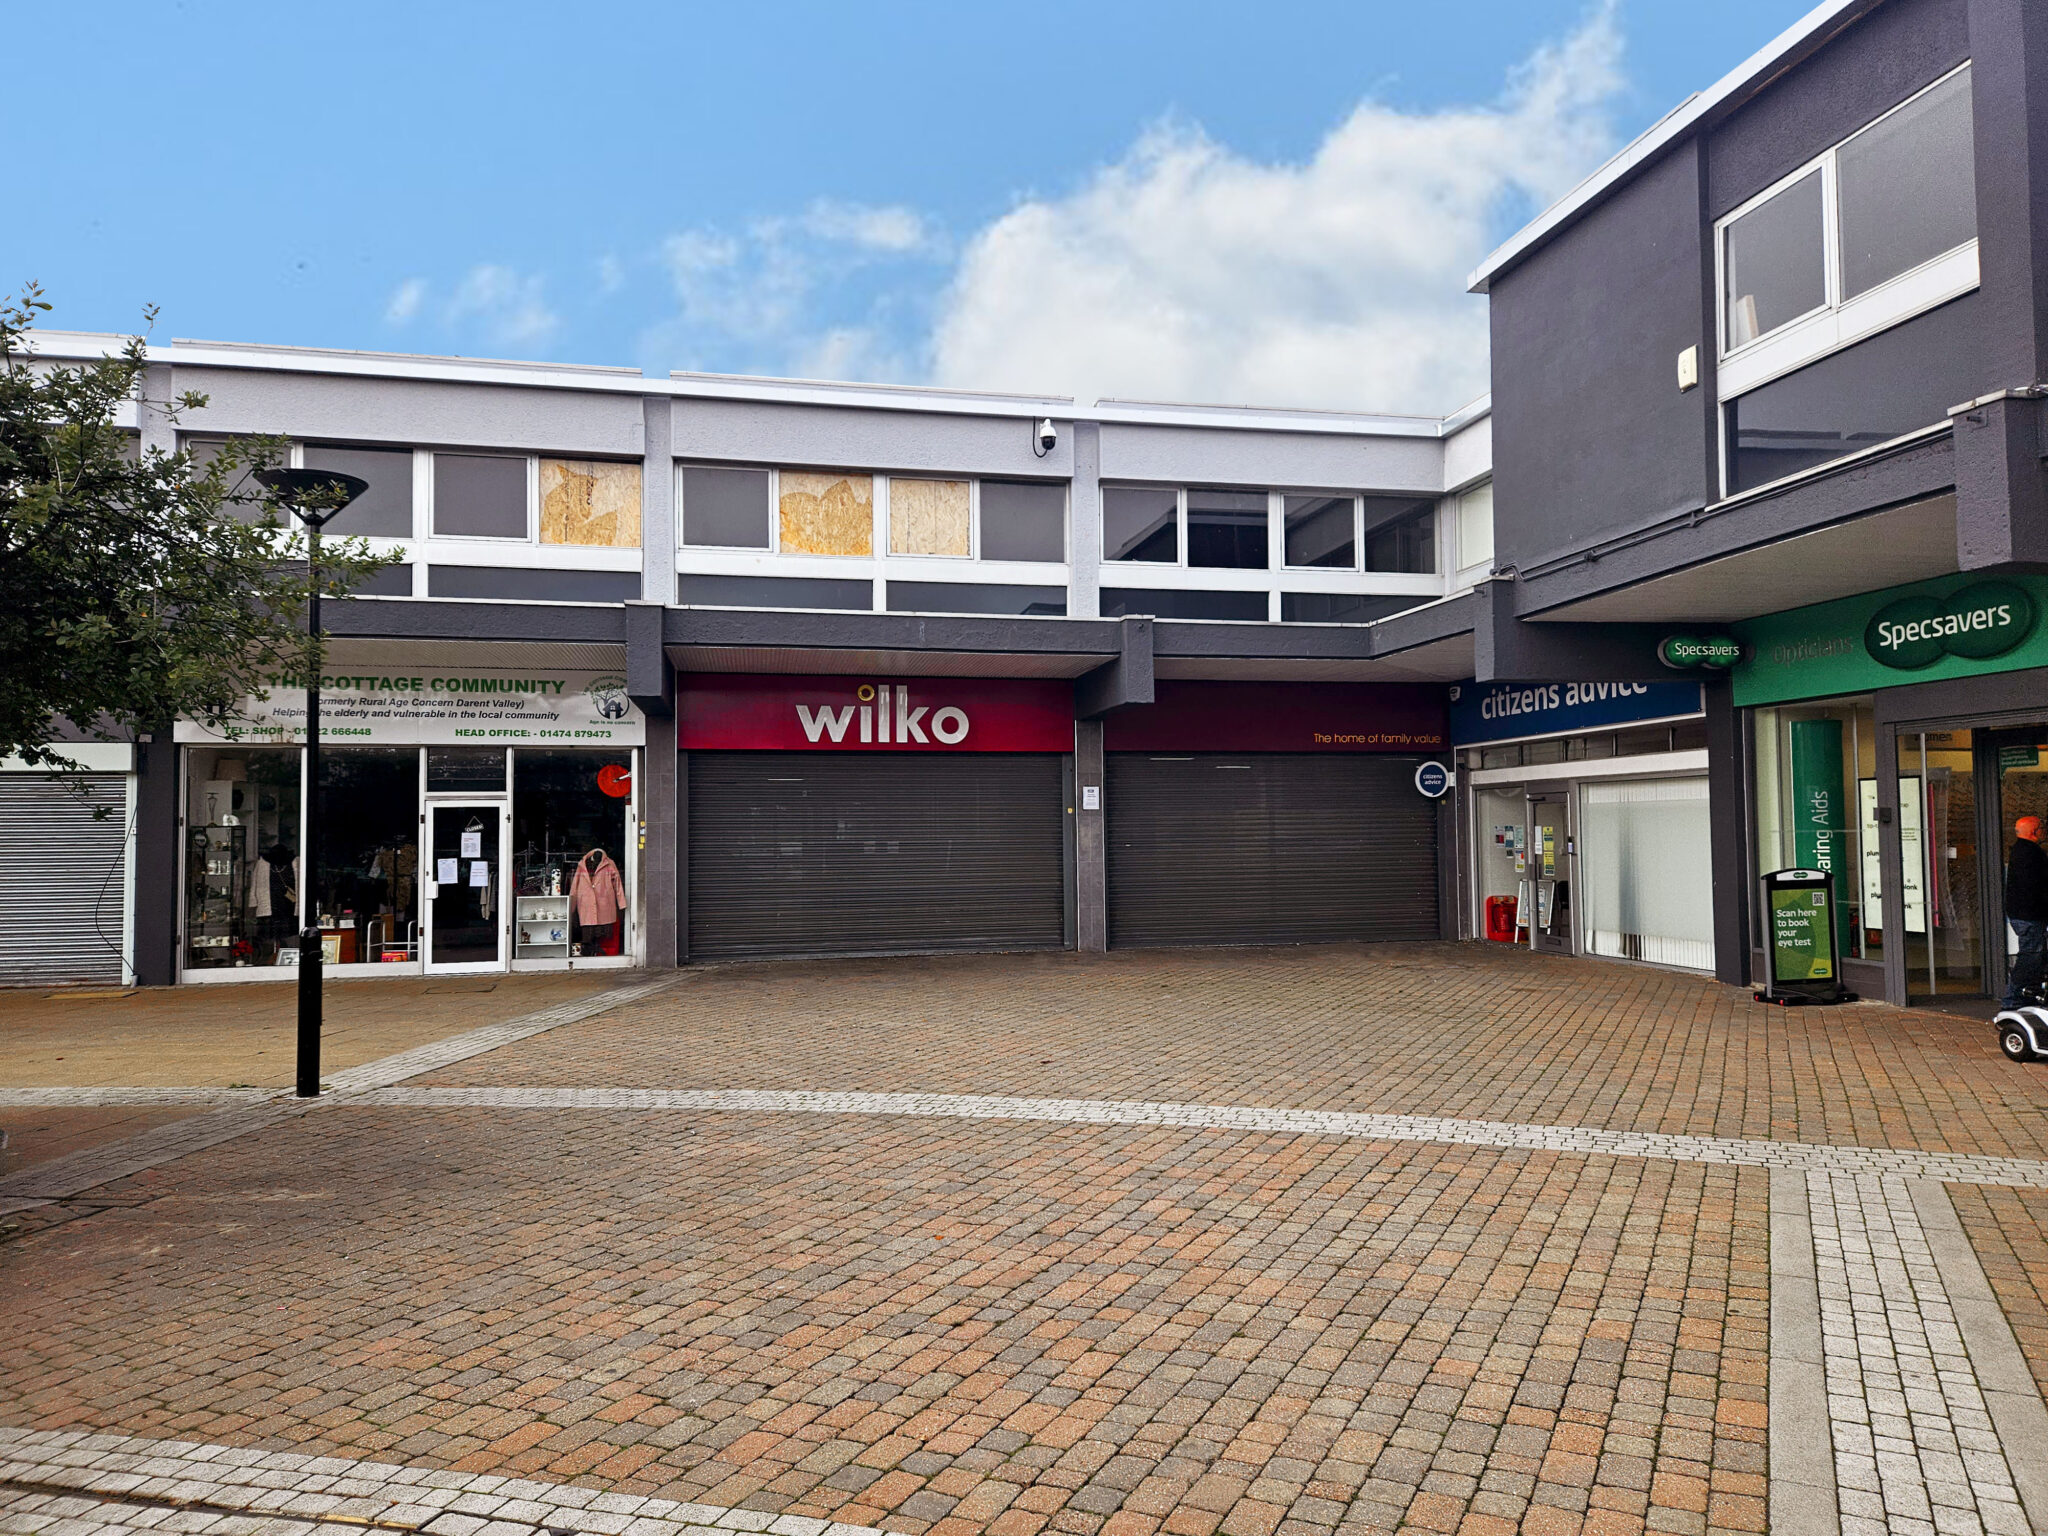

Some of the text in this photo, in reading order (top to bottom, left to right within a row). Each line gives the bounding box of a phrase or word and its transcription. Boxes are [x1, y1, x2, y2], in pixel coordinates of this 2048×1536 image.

[1878, 604, 2011, 650] Specsavers
[1675, 642, 1740, 657] Specsavers
[1774, 637, 1854, 668] Opticians
[319, 676, 424, 691] COTTAGE
[430, 677, 566, 694] COMMUNITY
[318, 698, 525, 709] ormerly Rural Age Concern Darent Valley)
[1481, 684, 1560, 719] citizens
[272, 708, 560, 721] Helpin he elderly and vulnerable in the local community
[796, 684, 970, 744] wilko
[224, 726, 249, 735] TEL:
[252, 727, 284, 735] SHOP
[331, 728, 372, 736] 666448
[455, 729, 486, 737] HEAD
[574, 730, 612, 738] 879473
[1314, 734, 1441, 745] The home of family value
[1811, 791, 1833, 873] aring Aids
[1776, 908, 1817, 918] Scan here
[1788, 918, 1810, 927] book
[1777, 930, 1797, 938] your
[1778, 938, 1812, 949] eye test
